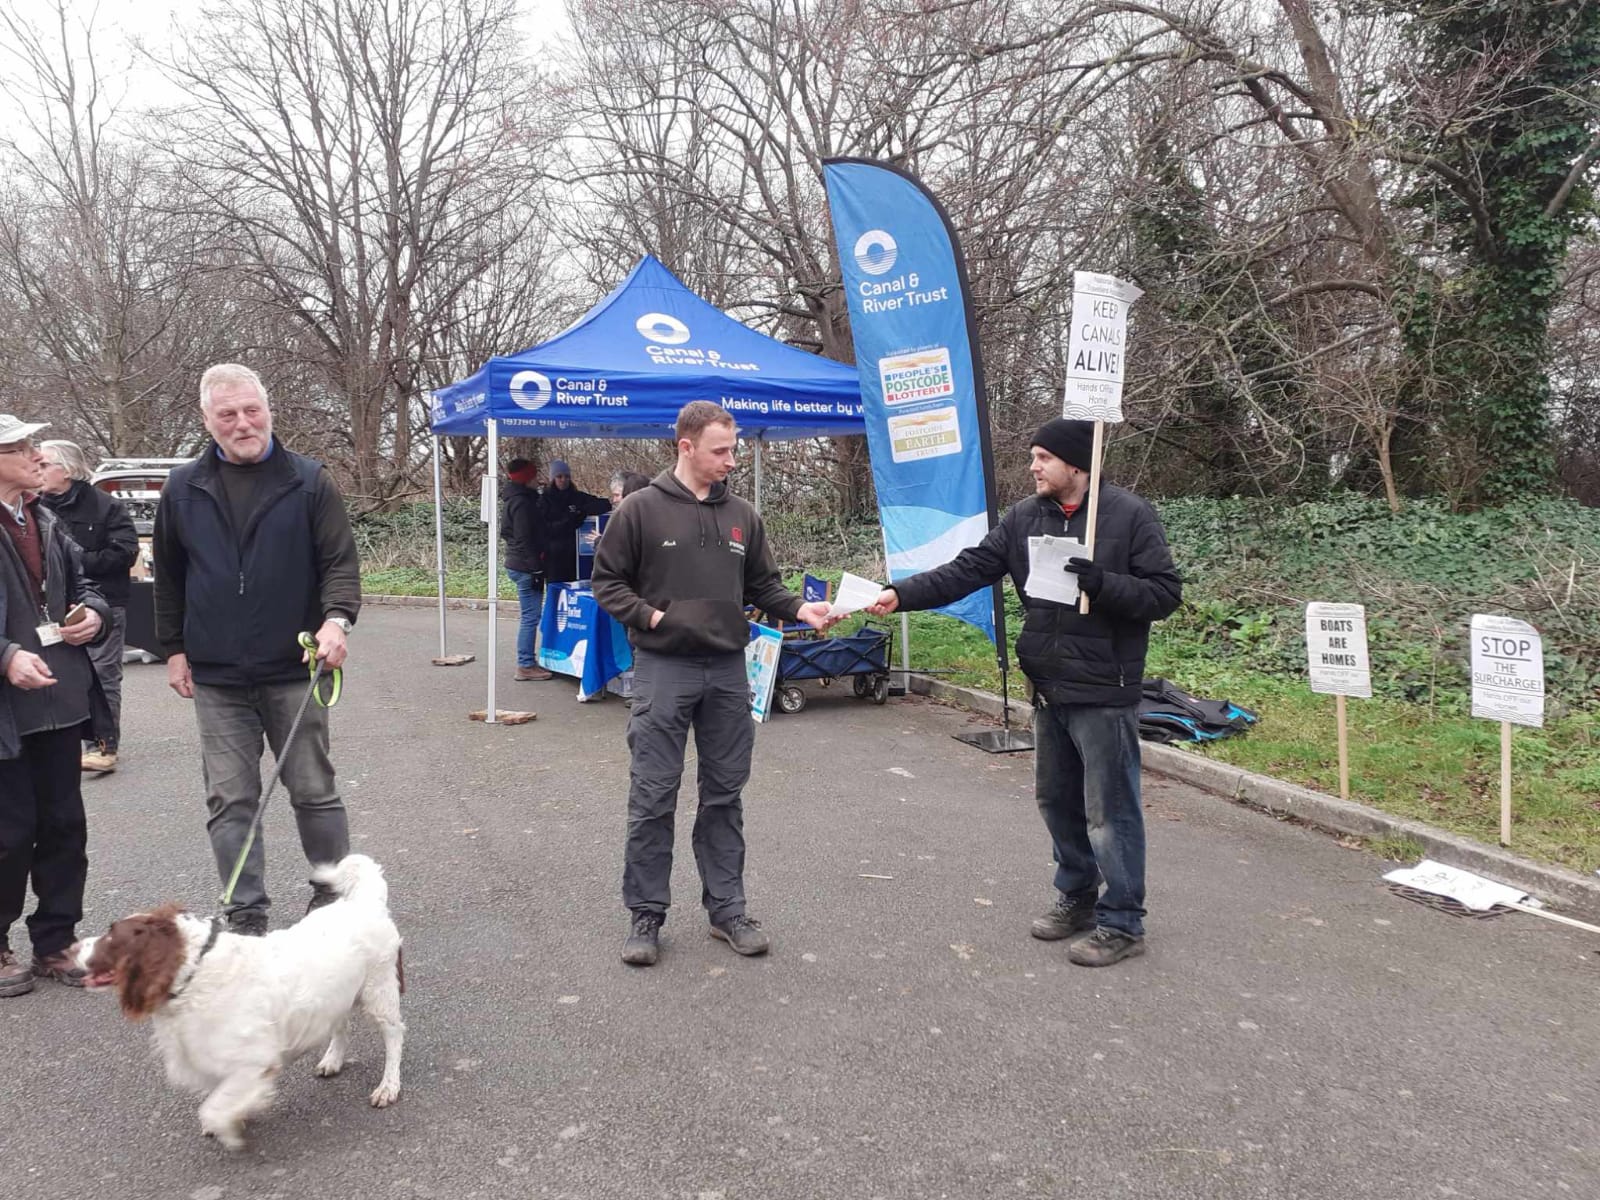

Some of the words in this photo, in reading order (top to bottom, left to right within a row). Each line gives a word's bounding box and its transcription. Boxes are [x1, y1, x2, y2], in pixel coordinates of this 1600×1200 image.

[860, 276, 905, 297] Canal
[909, 273, 920, 288] &
[863, 296, 904, 314] River
[905, 287, 948, 307] Trust
[1093, 300, 1119, 320] KEEP
[1082, 324, 1121, 346] CANALS
[646, 346, 705, 359] Canal
[708, 350, 721, 360] &
[653, 356, 704, 367] River
[704, 359, 760, 371] Trust
[892, 366, 940, 380] PEOPLE'S
[556, 378, 595, 391] Canal
[598, 380, 608, 391] &
[885, 373, 949, 393] POSTCODE
[556, 392, 593, 406] River
[594, 394, 629, 407] Trust
[895, 386, 943, 401] LOTTERY
[722, 397, 768, 413] Making
[772, 399, 791, 412] life
[795, 400, 832, 413] better
[837, 401, 853, 415] by
[906, 434, 945, 449] EARTH
[1320, 619, 1353, 632] BOATS
[1329, 636, 1347, 649] ARE
[1481, 636, 1531, 656] STOP
[1321, 653, 1356, 666] HOMES
[1494, 661, 1517, 674] THE
[1473, 672, 1541, 689] SURCHARGE!
